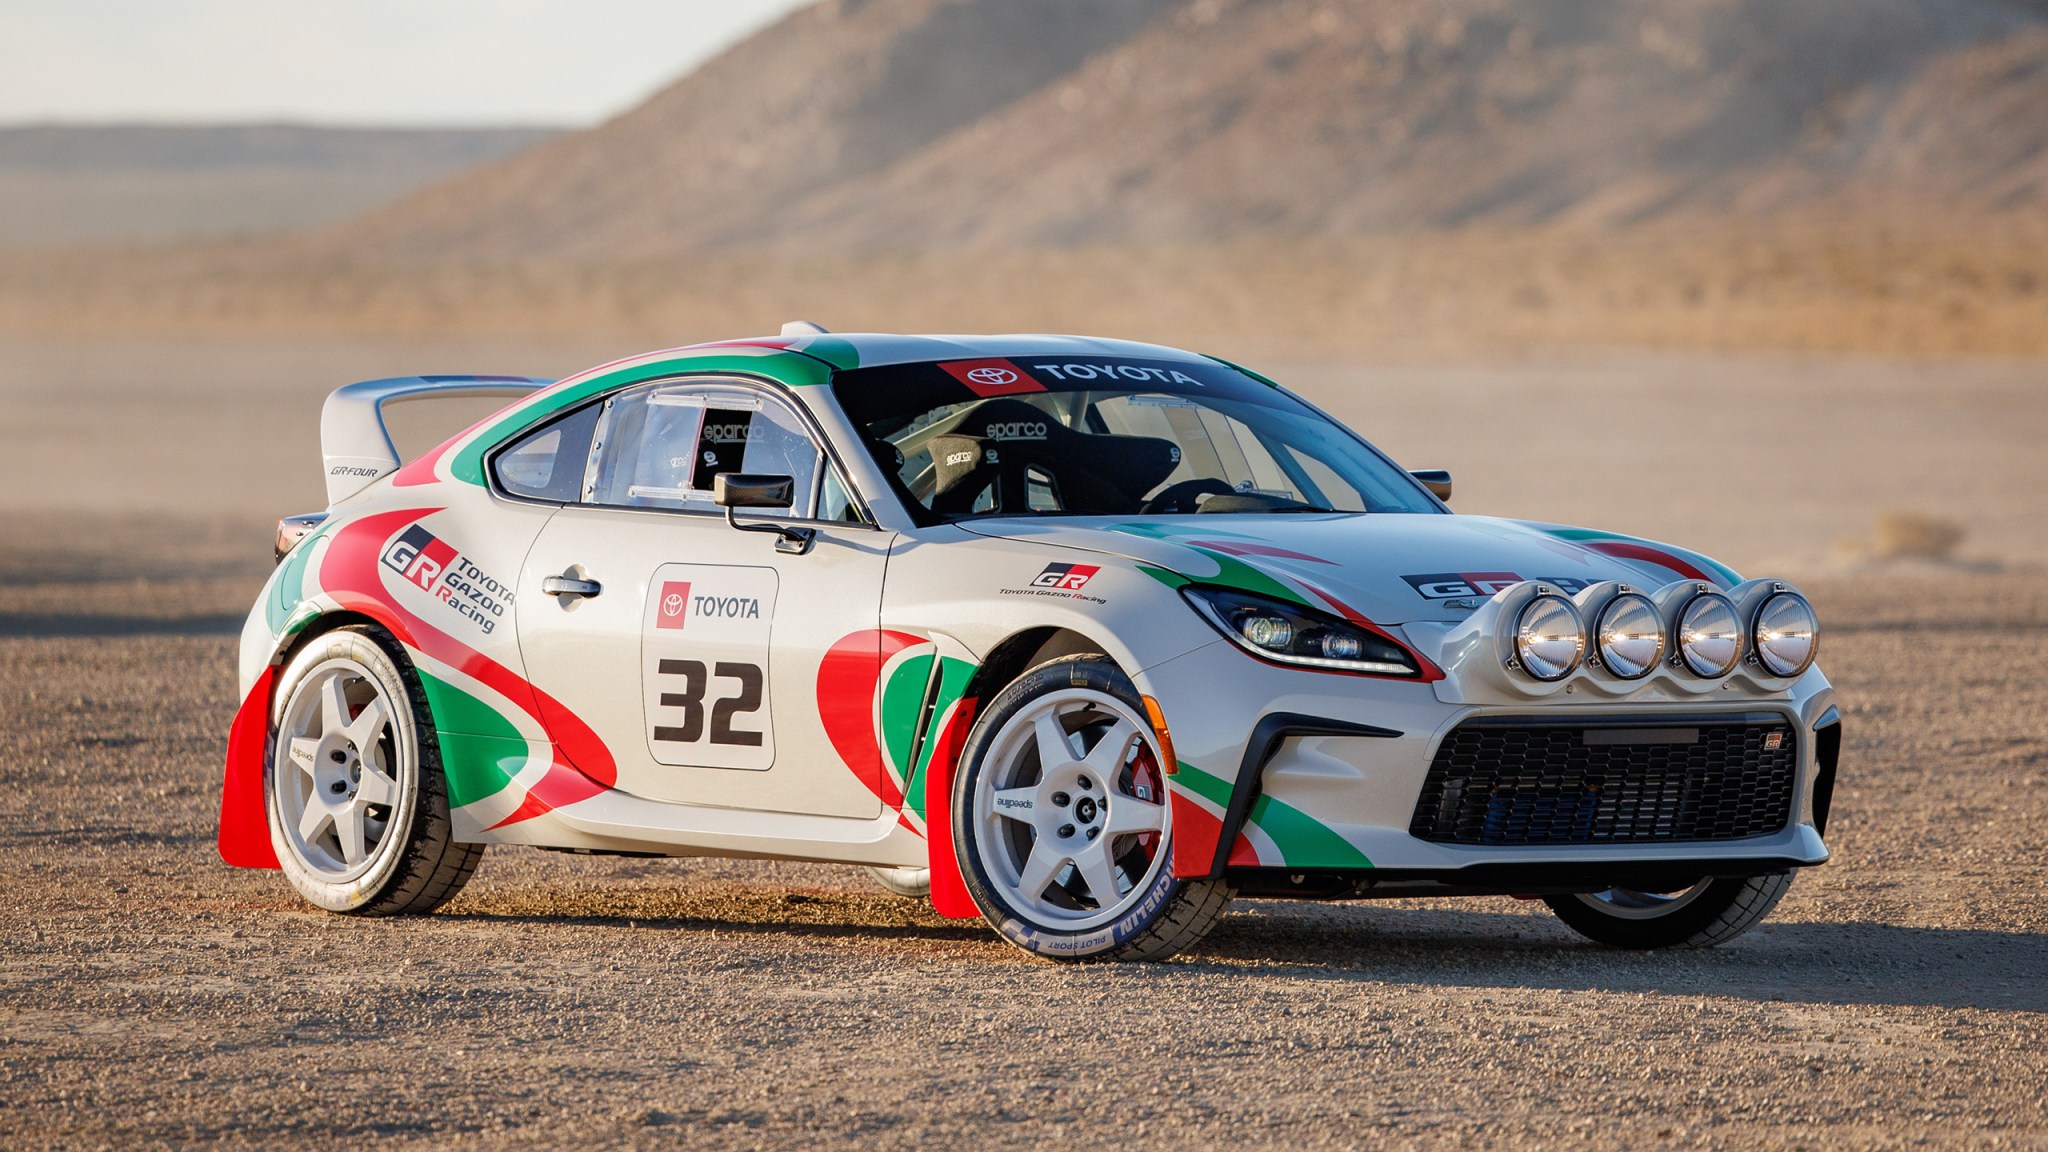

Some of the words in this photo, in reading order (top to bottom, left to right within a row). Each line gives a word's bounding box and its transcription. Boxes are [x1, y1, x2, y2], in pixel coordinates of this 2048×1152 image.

[1033, 363, 1205, 387] TOYOTA
[703, 424, 765, 444] sparco
[986, 421, 1047, 441] sparco
[946, 451, 972, 465] sparco
[385, 540, 442, 590] GR
[458, 556, 516, 606] TOYOTA
[1033, 572, 1089, 589] GR
[444, 572, 505, 617] GAZOO
[999, 588, 1035, 596] TOYOTA
[1036, 590, 1072, 599] GAZOO
[1072, 593, 1108, 605] Racing
[435, 585, 496, 635] Racing
[694, 596, 760, 619] TOYOTA
[653, 658, 764, 747] 32
[996, 797, 1034, 809] speedline
[1120, 855, 1174, 937] ICHELIN
[1048, 941, 1079, 950] SPORT
[1079, 936, 1107, 949] PILOT
